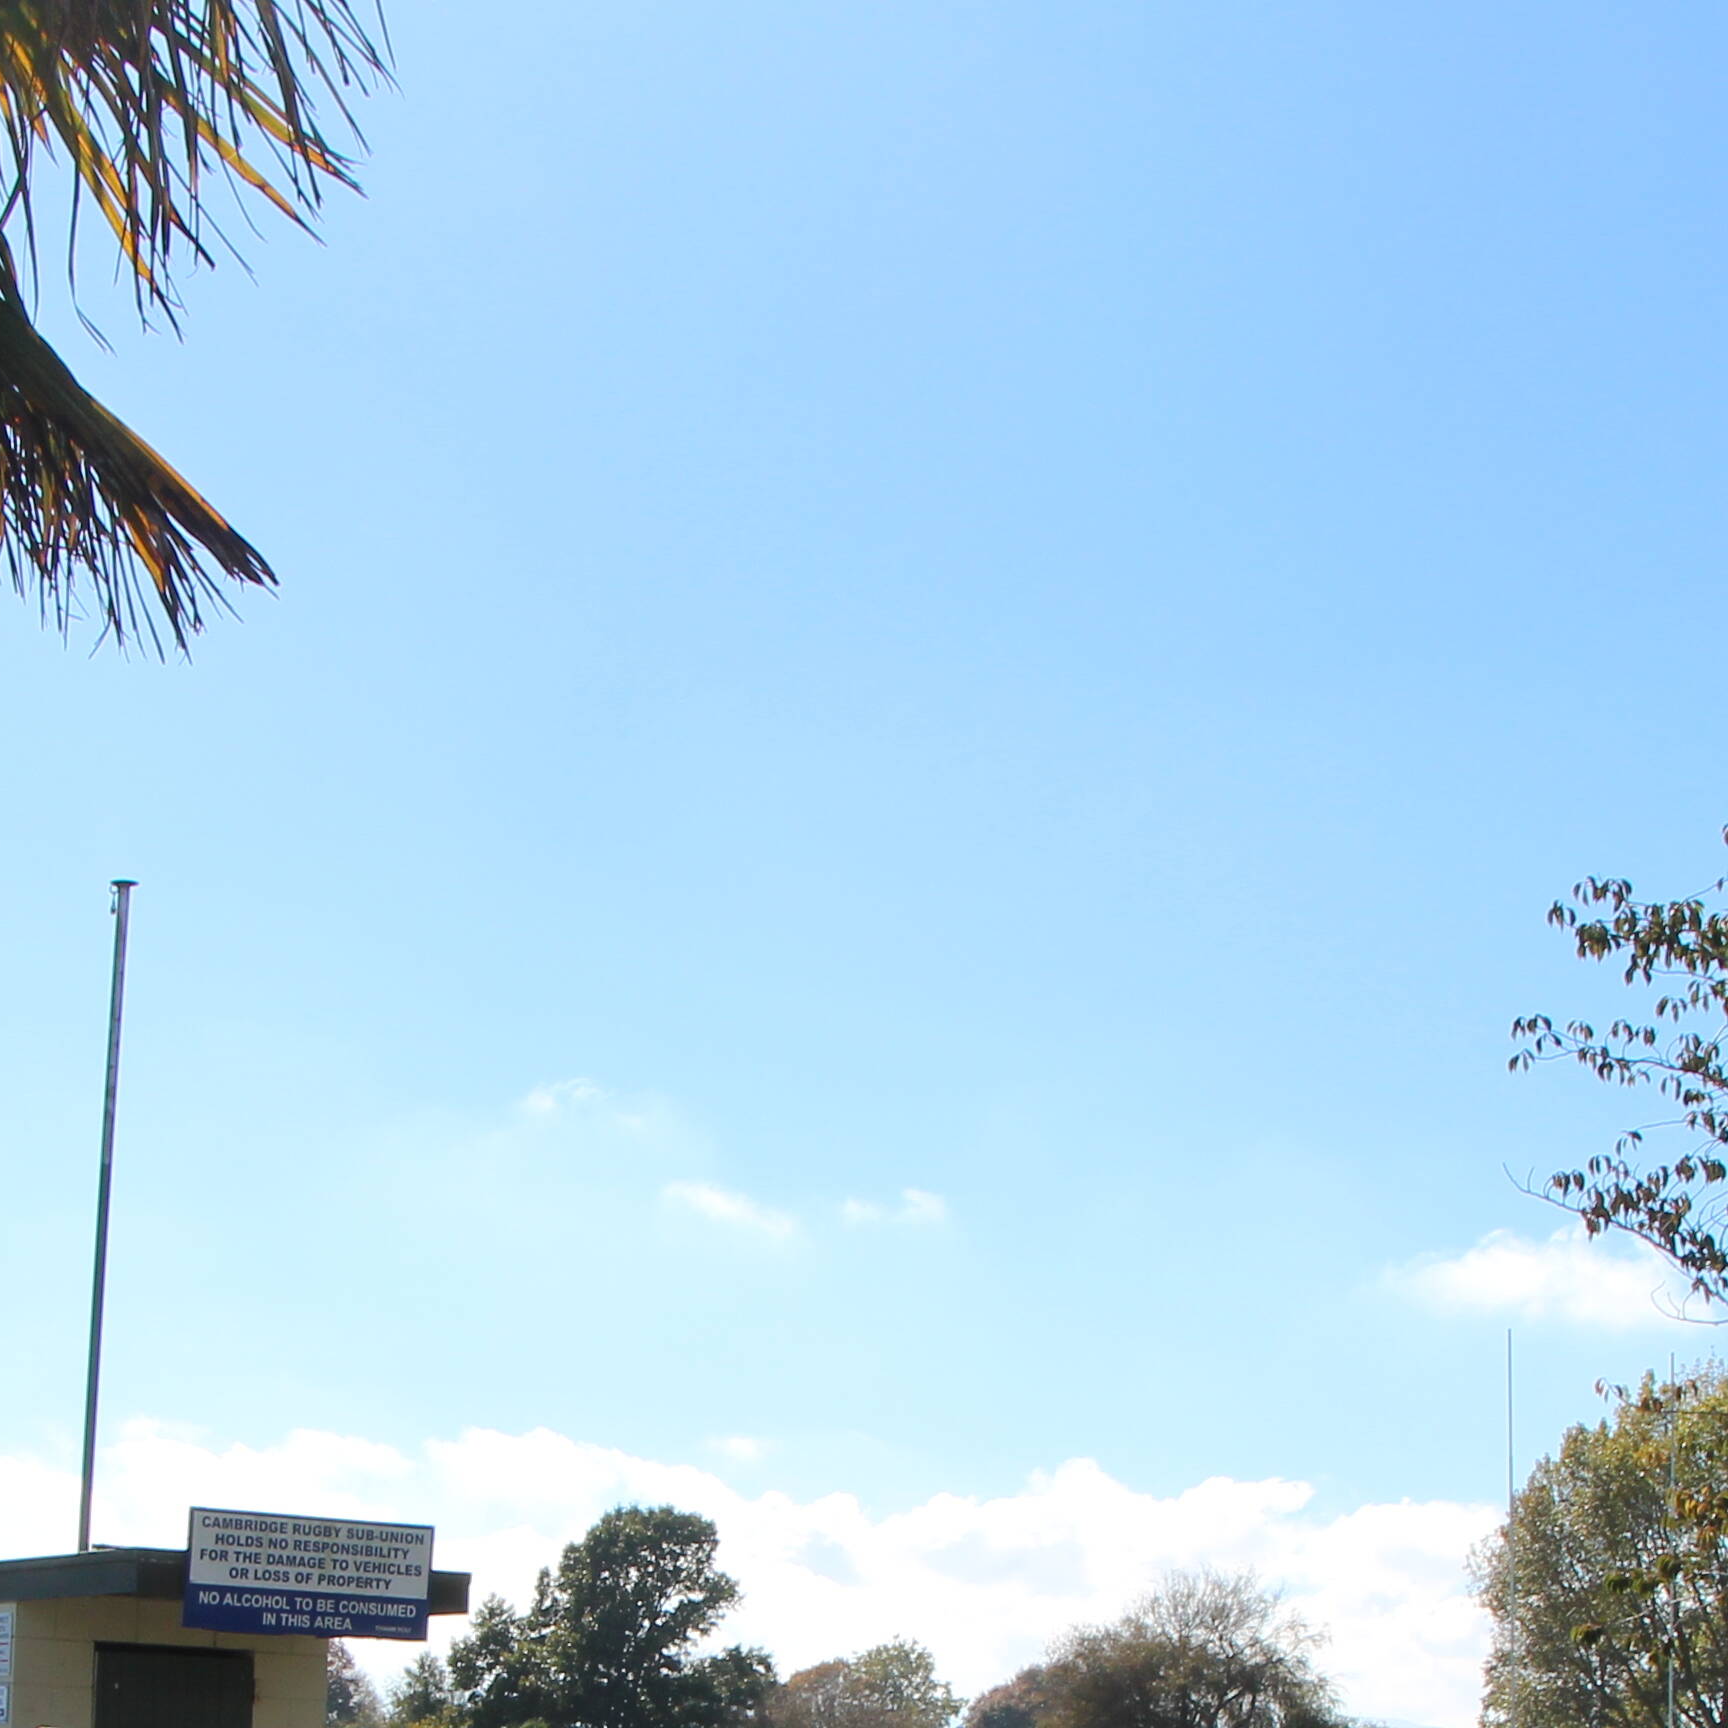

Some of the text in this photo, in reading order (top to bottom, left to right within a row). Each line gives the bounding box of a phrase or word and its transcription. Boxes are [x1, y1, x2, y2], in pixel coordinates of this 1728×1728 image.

[202, 1515, 425, 1545] CAMBRIDGE RUGBY SUB-UNION
[214, 1533, 410, 1560] HOLDS NO RESPONSIBILITY
[200, 1548, 422, 1577] FOR THE DAMAGE TO VEHICLES
[229, 1566, 392, 1591] OR LOSS OF PROPERTY
[198, 1591, 417, 1618] NO ALCOHOL TO BE CONSUMED
[262, 1611, 352, 1631] IN THIS AREA
